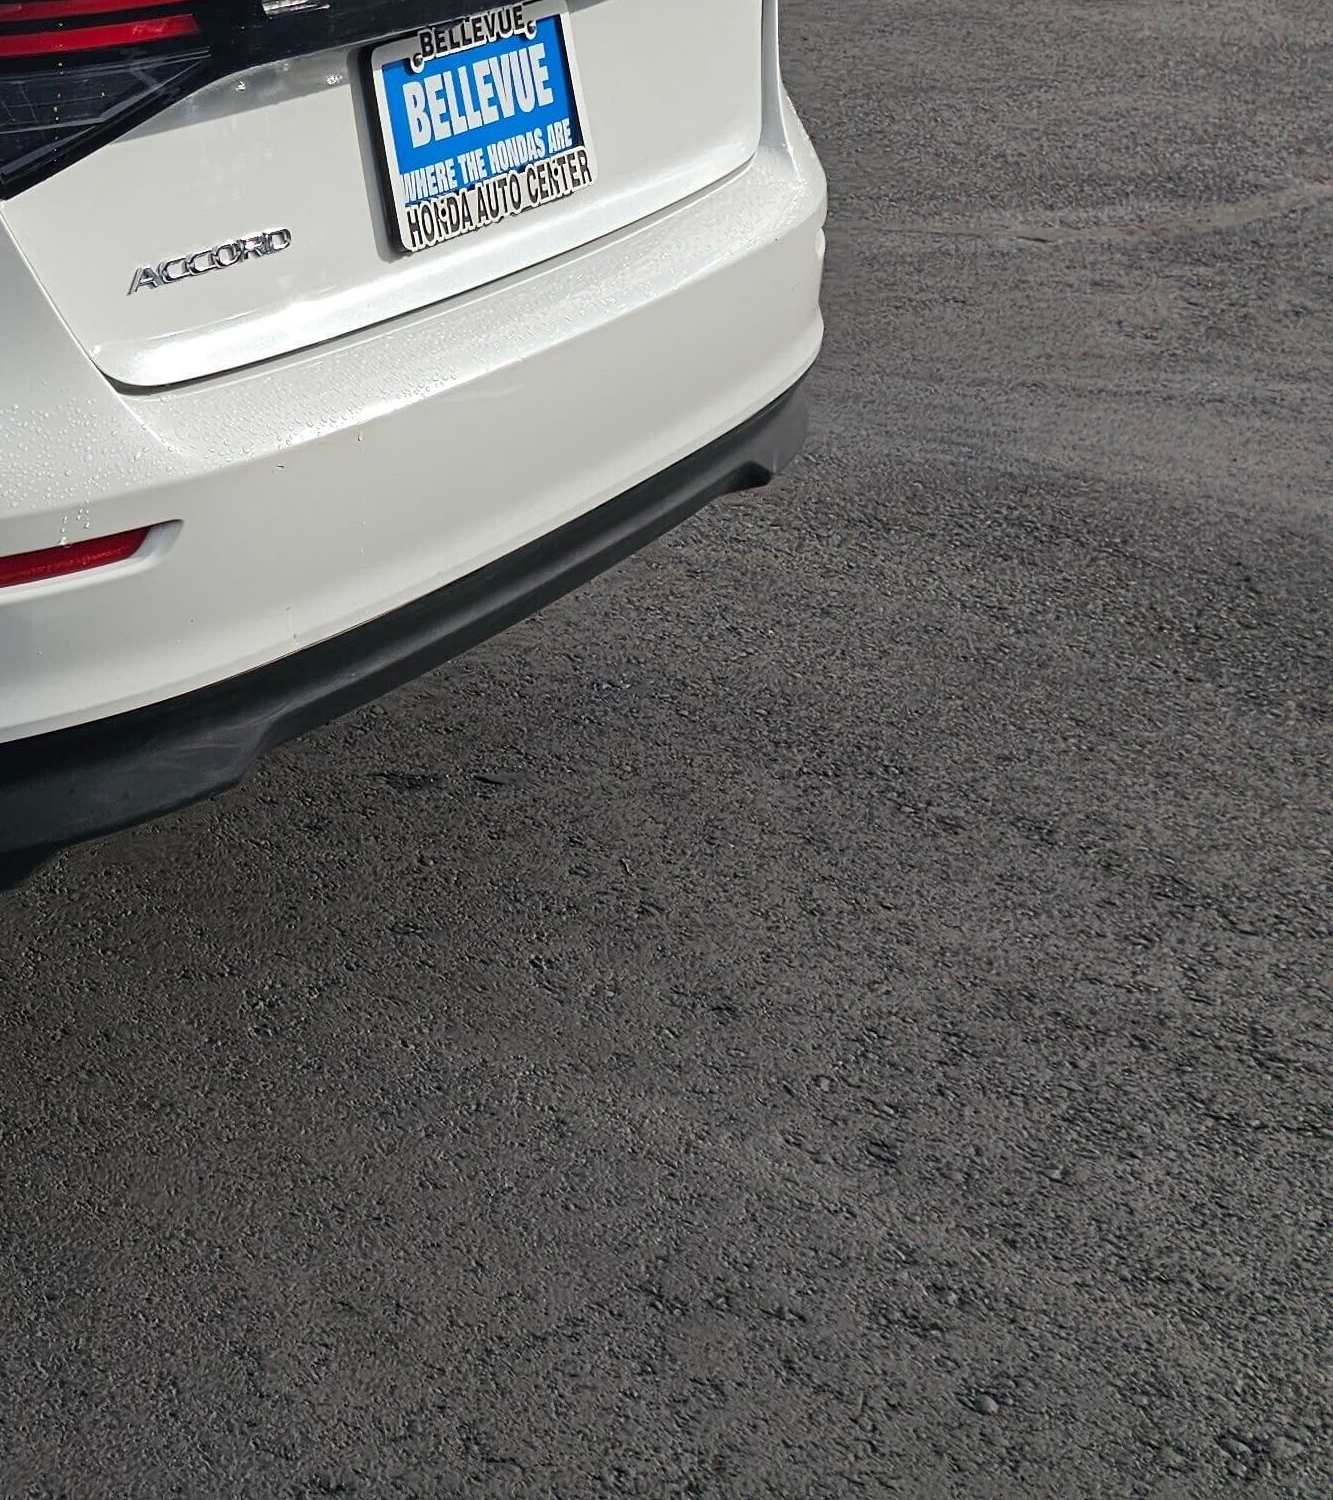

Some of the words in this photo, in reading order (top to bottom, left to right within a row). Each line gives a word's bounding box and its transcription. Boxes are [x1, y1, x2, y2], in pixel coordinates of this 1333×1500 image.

[418, 5, 525, 58] BELLEVUE
[402, 43, 554, 148] BELLEVUE
[400, 158, 458, 202] WHERE
[458, 148, 488, 184] THE
[487, 128, 546, 175] HONDAS
[546, 118, 573, 154] ARE
[406, 191, 474, 248] HONDA
[477, 173, 522, 223] AUTO
[526, 149, 593, 205] CENTER
[126, 228, 292, 296] ACCORD
